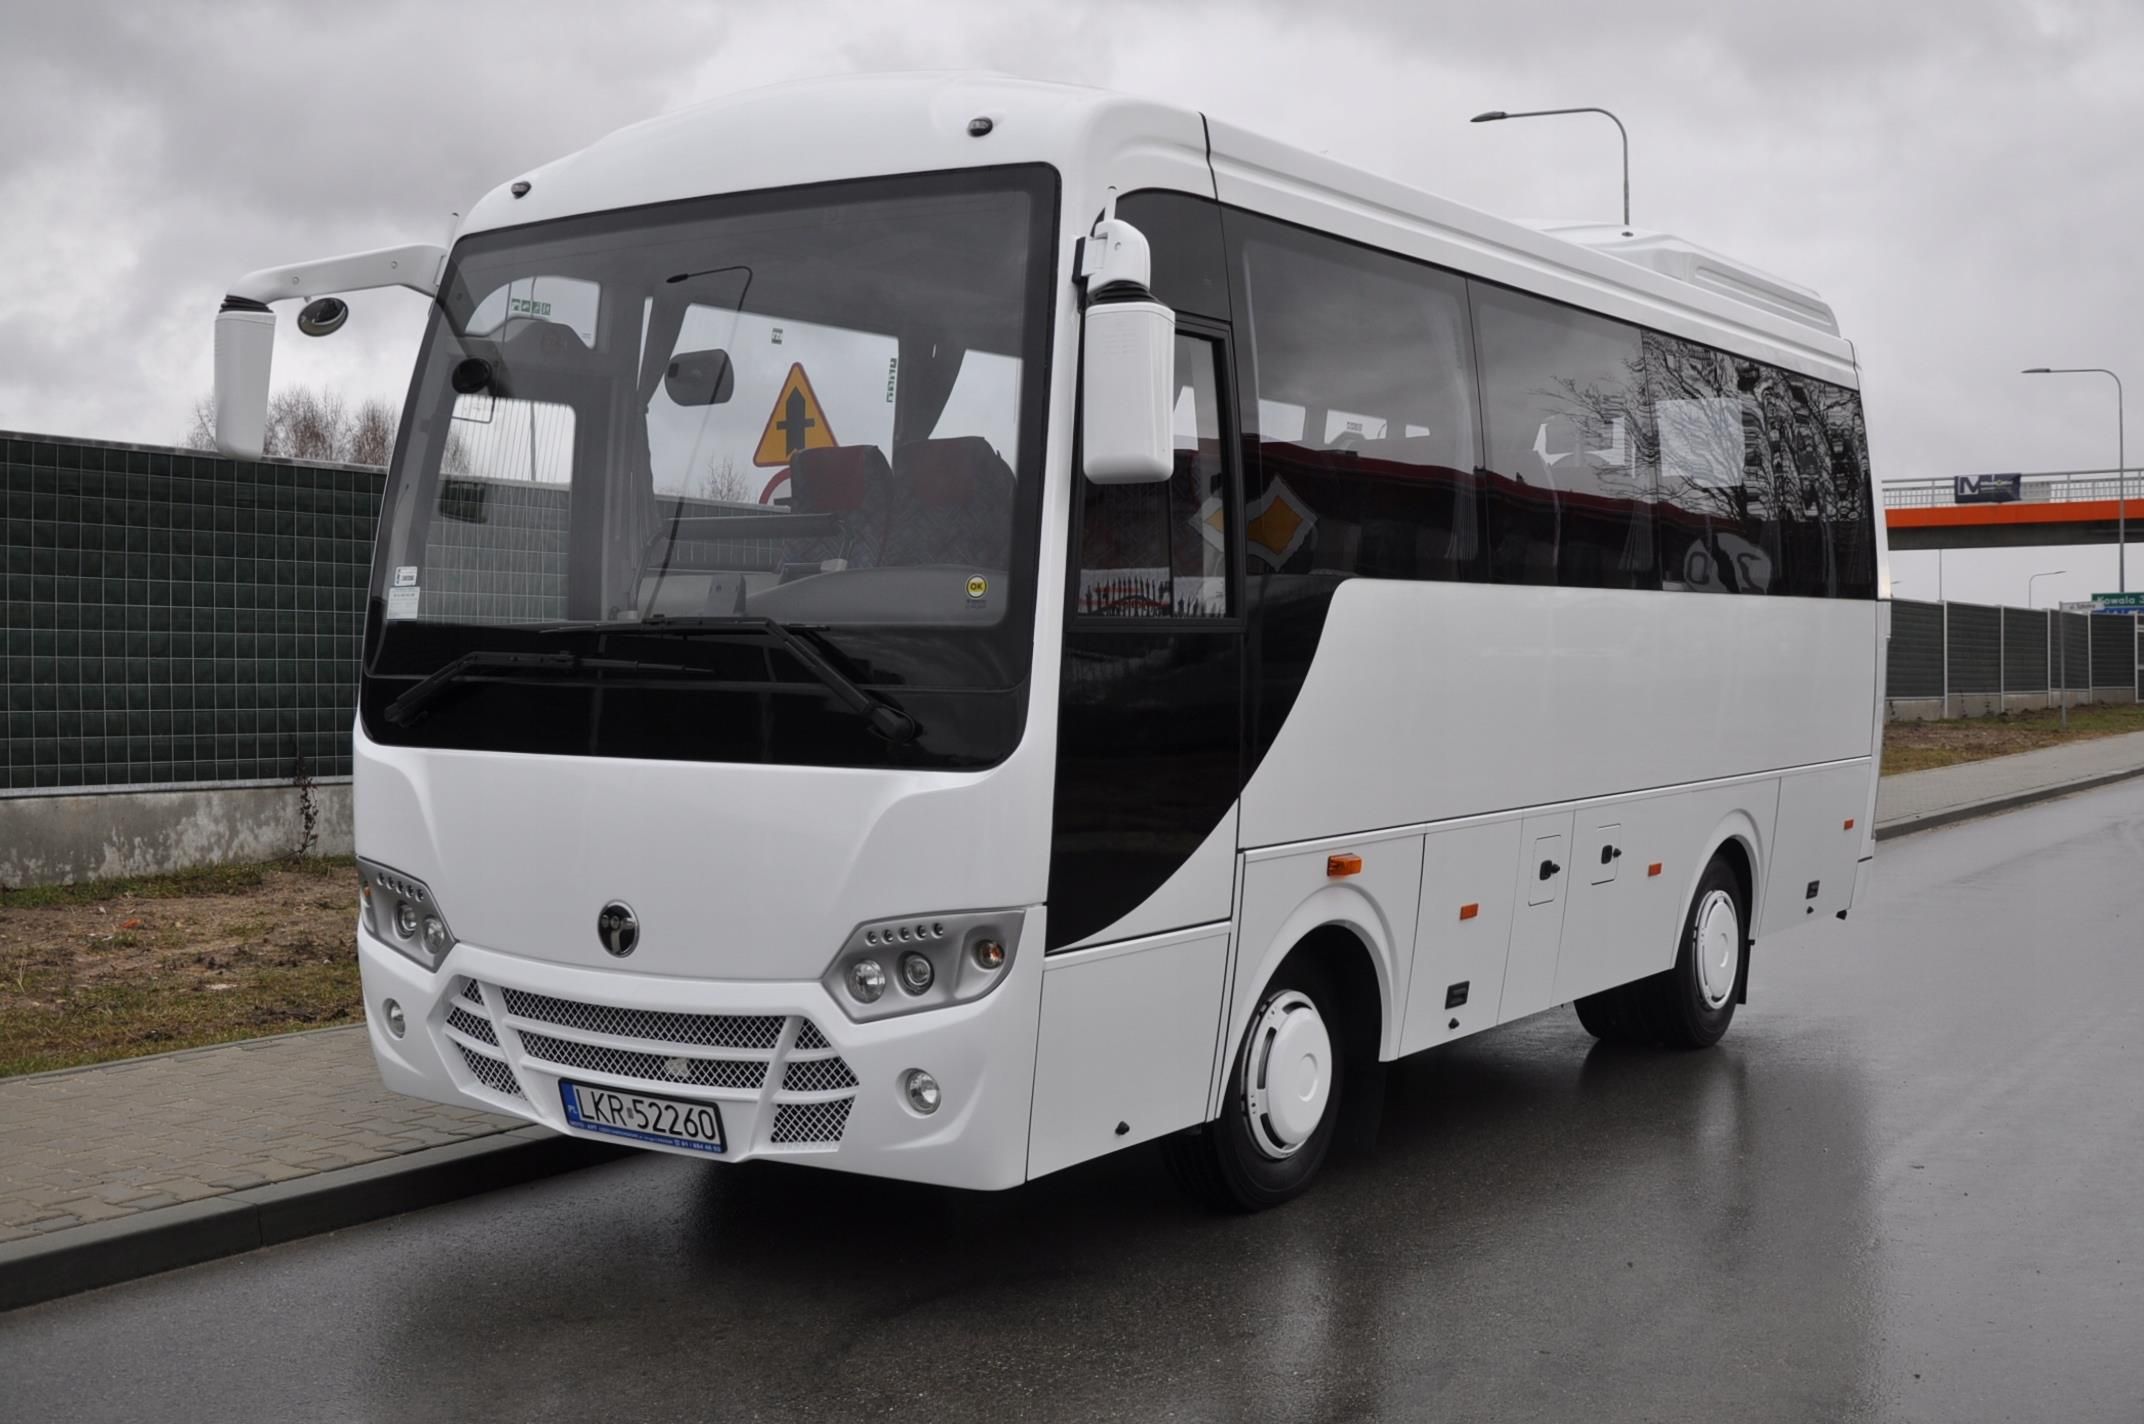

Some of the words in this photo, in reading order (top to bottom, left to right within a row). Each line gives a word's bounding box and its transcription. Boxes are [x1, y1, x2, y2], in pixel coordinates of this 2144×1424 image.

[970, 582, 985, 591] OK
[567, 1105, 578, 1114] PL
[575, 1088, 627, 1126] LKR
[632, 1099, 716, 1140] 52260
